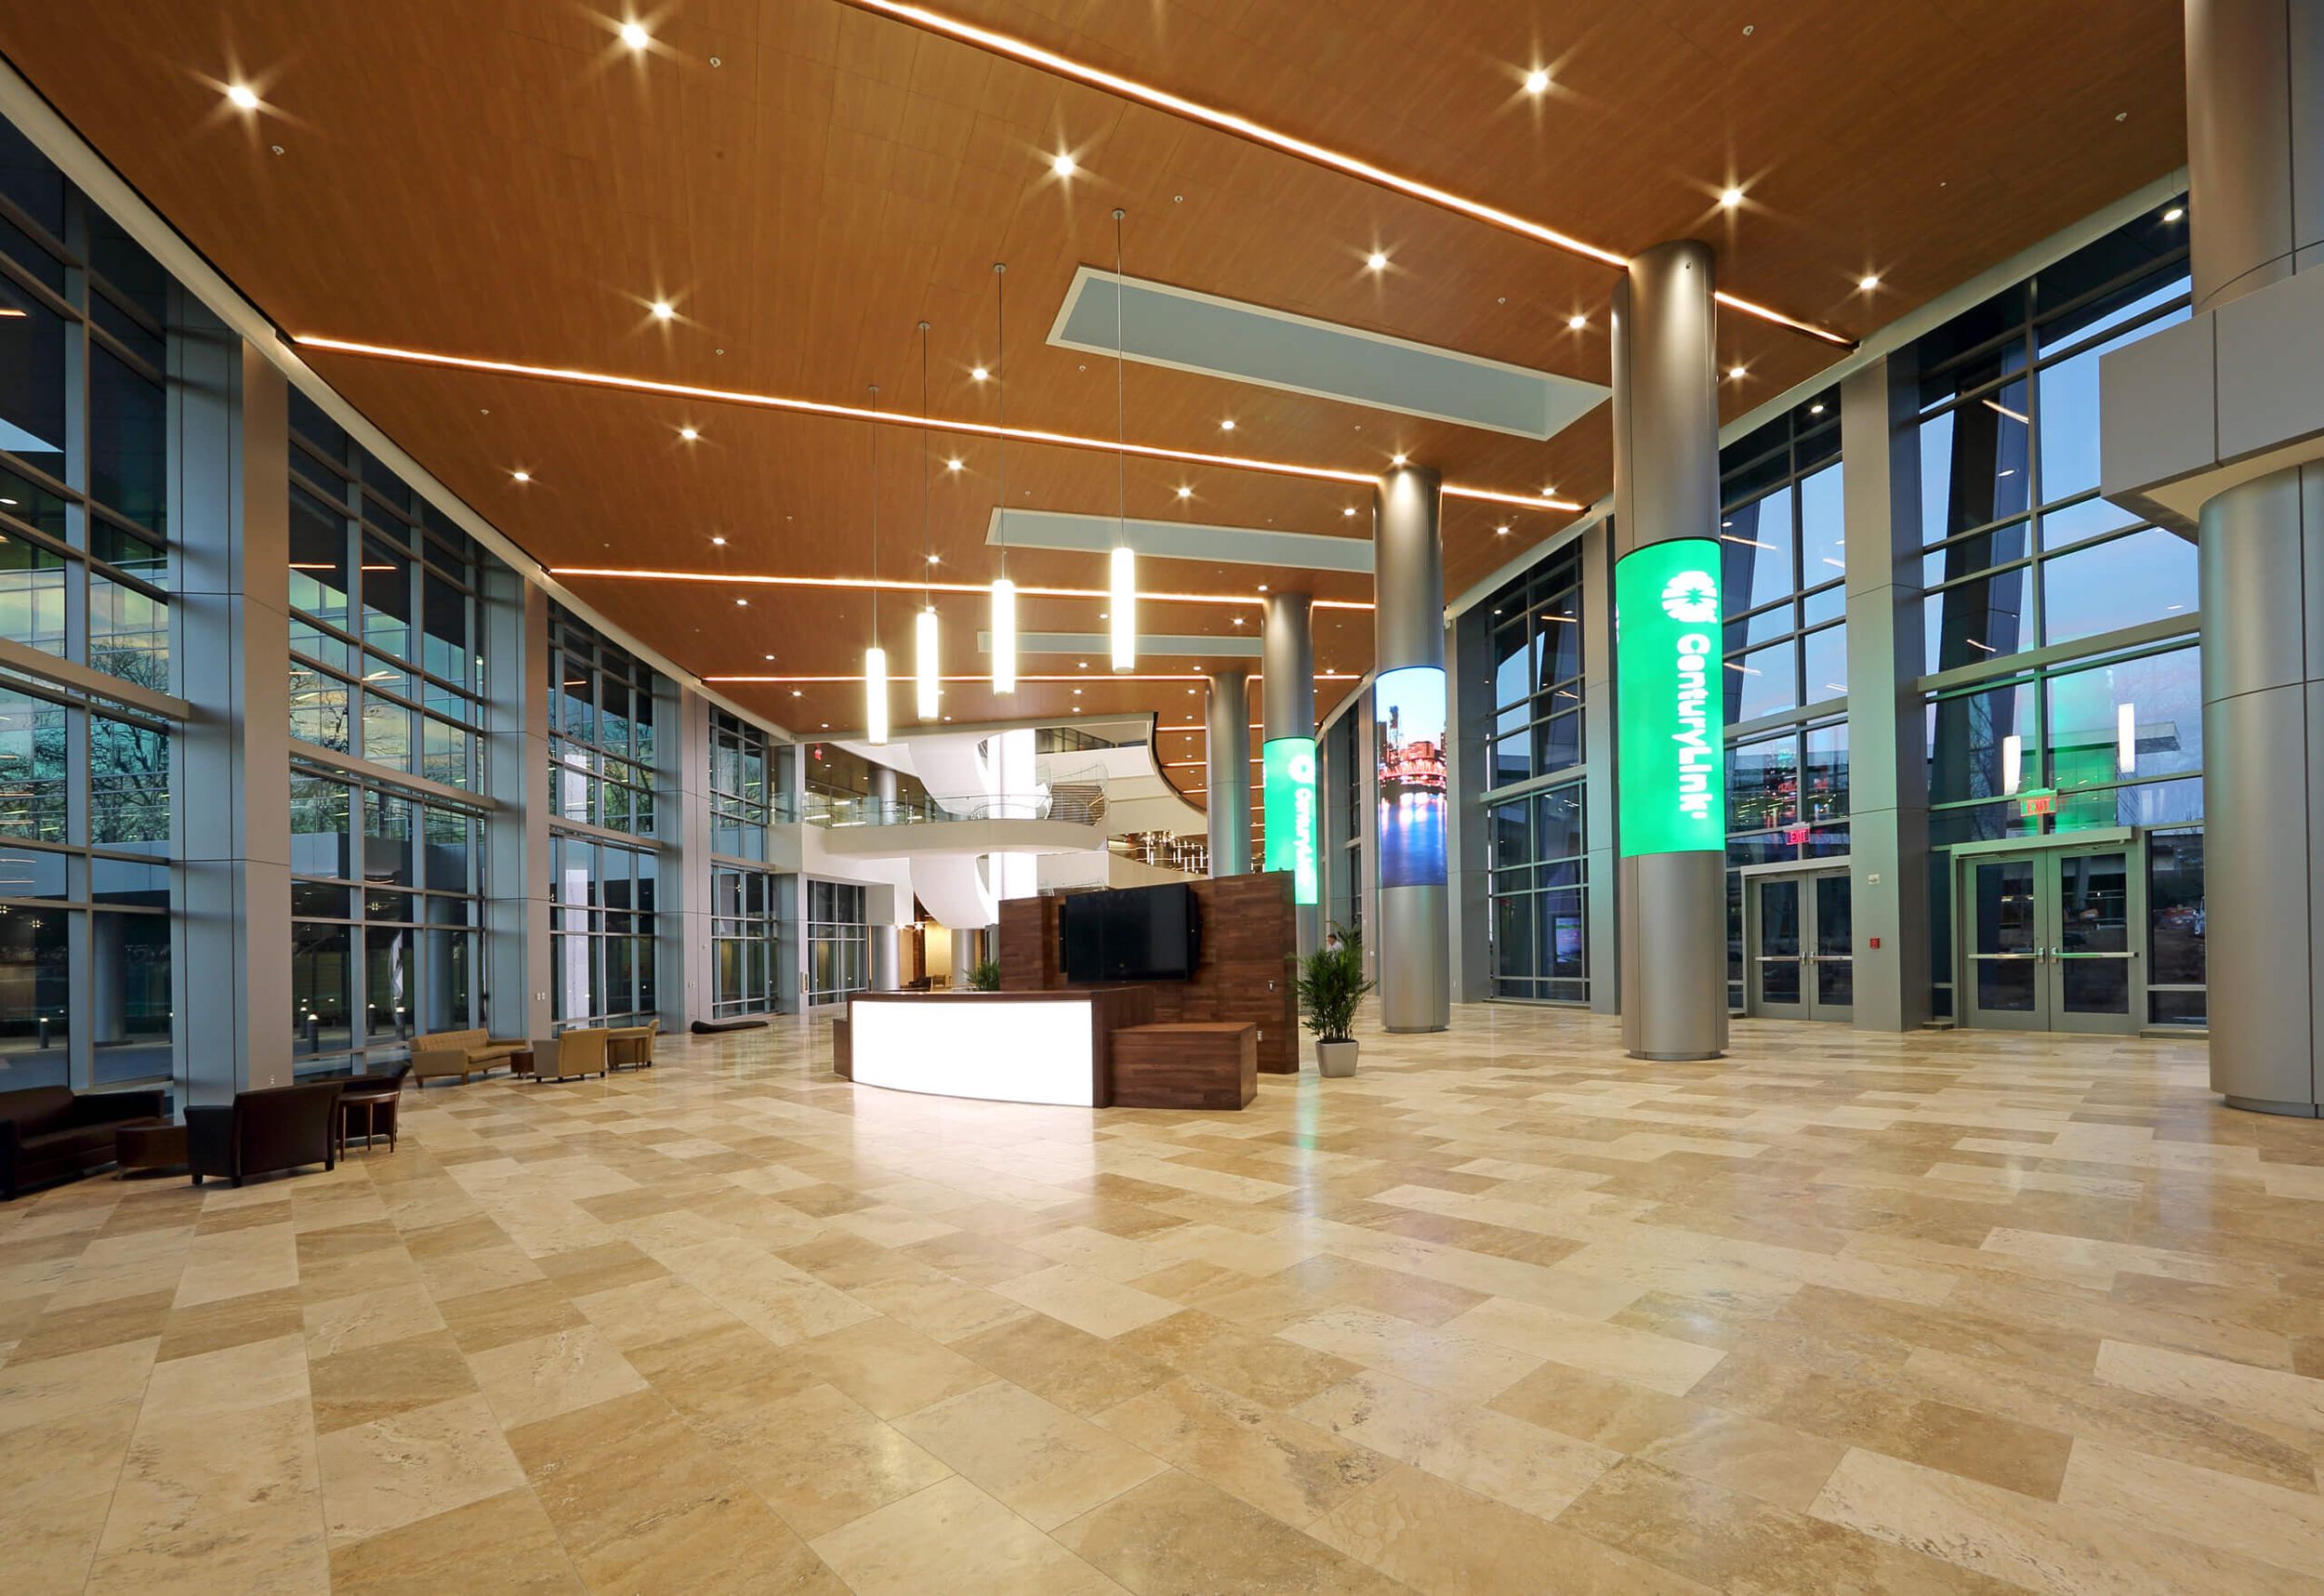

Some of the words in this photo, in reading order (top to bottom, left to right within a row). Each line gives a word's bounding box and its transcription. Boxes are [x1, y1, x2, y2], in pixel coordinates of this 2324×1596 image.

[1671, 633, 1712, 814] CenturyLink
[2027, 797, 2051, 812] EXIT
[1789, 829, 1806, 843] EXIT
